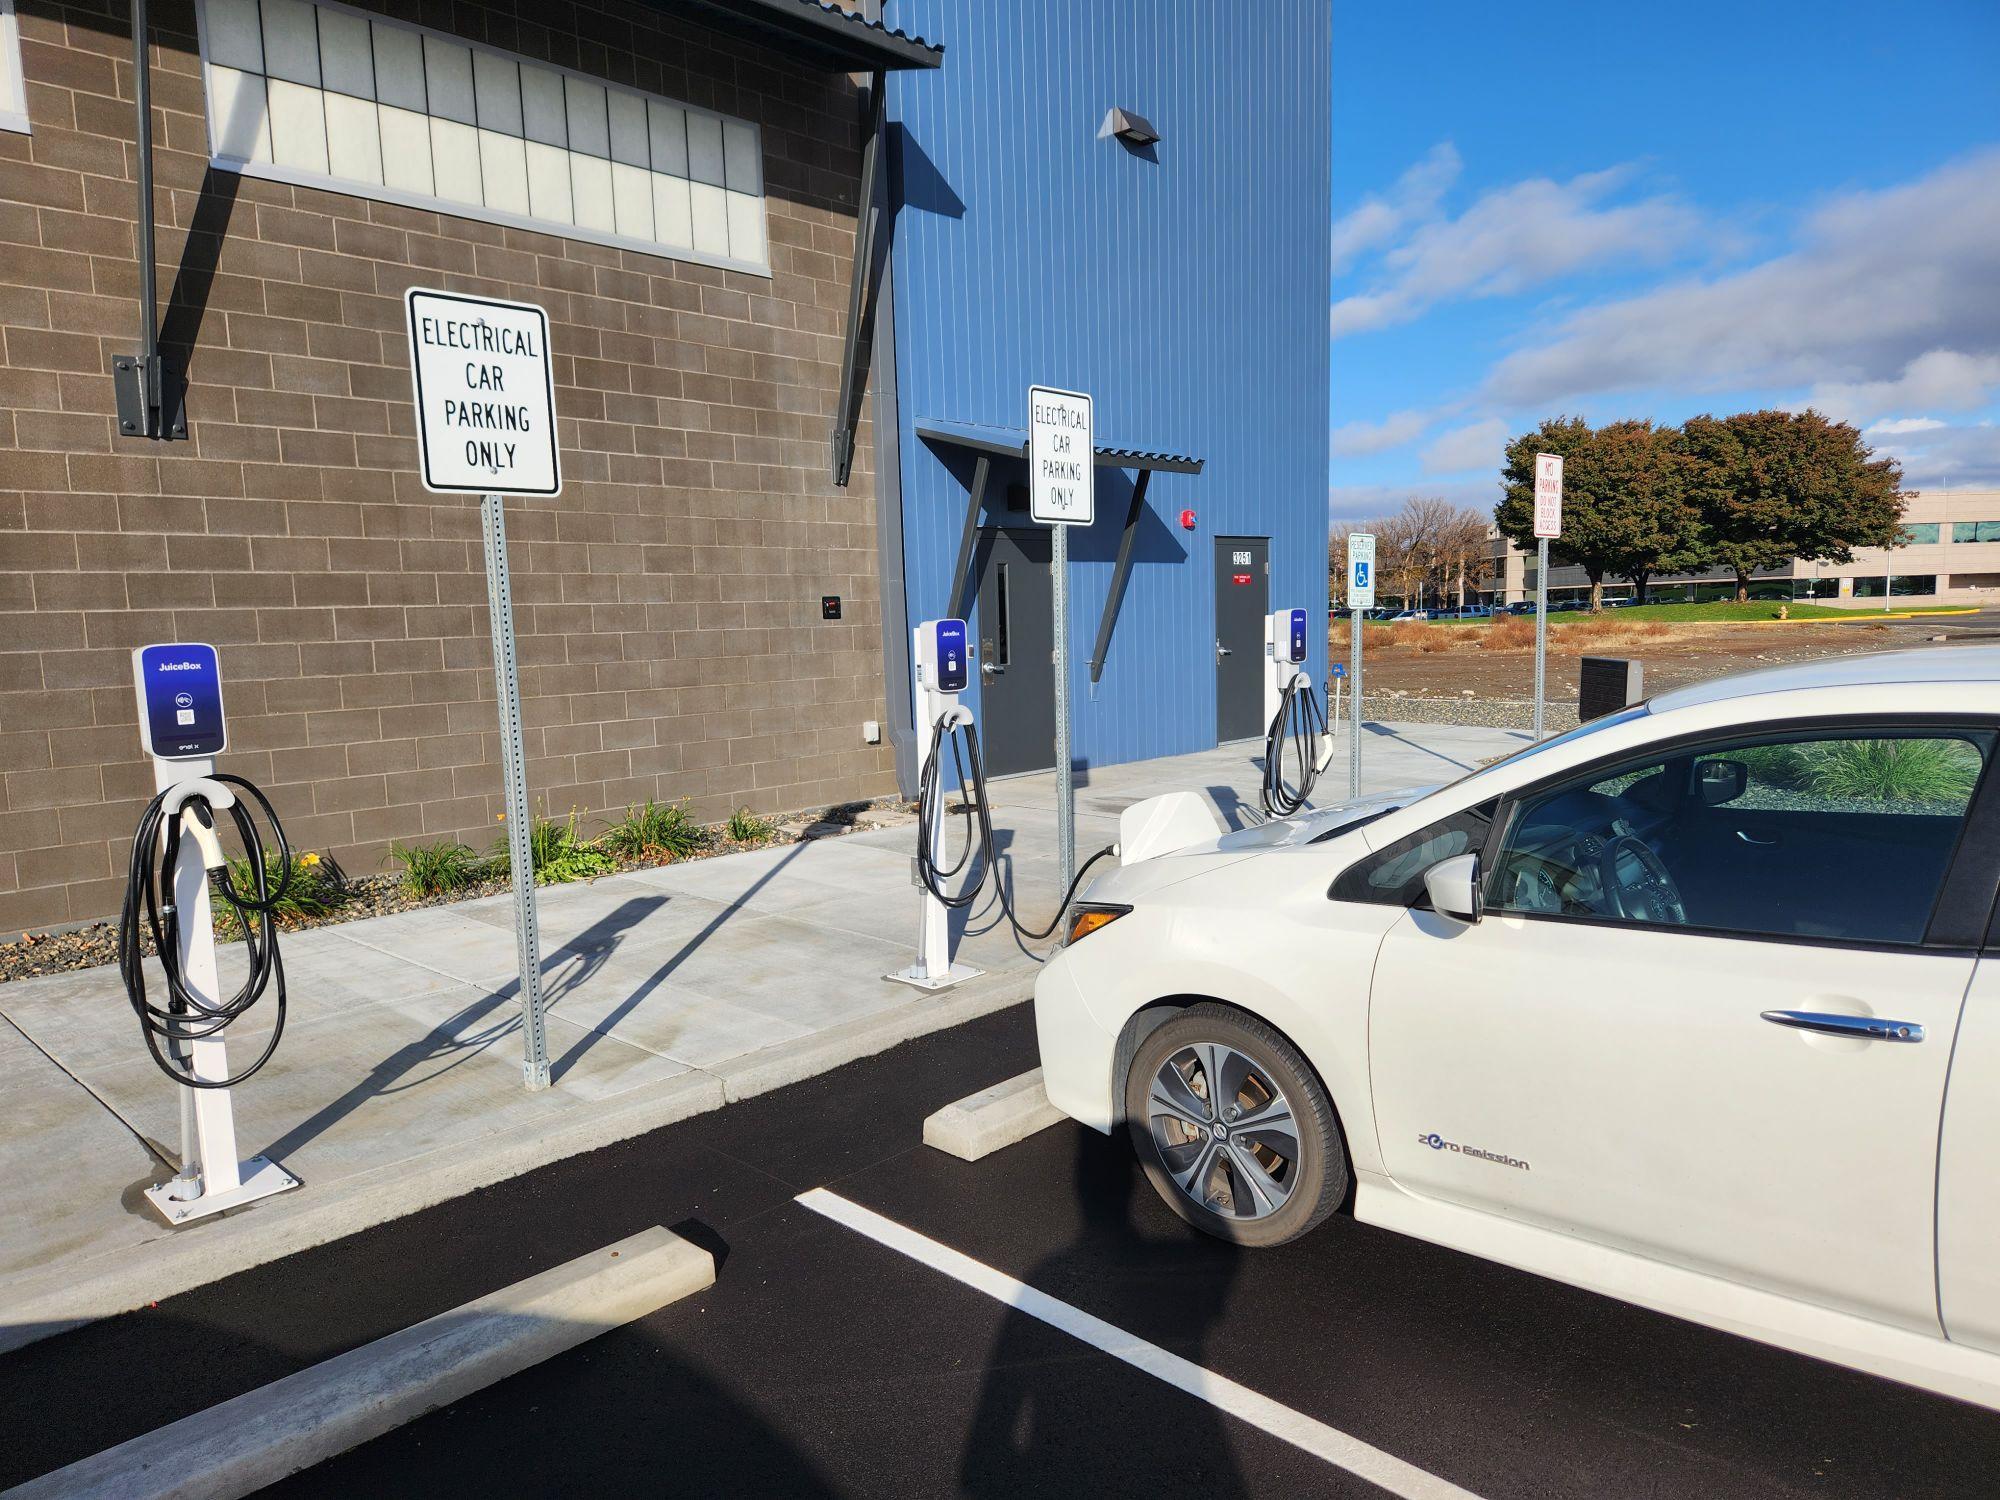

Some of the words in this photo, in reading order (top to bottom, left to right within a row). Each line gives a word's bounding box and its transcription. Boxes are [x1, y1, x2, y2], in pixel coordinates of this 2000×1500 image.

[423, 317, 538, 358] ELECTRICAL
[466, 362, 504, 392] CAR
[445, 400, 530, 432] PARKING
[1035, 404, 1087, 430] ELECTRICAL
[466, 440, 516, 469] ONLY
[1053, 434, 1071, 454] CAR
[1042, 459, 1081, 481] PARKING
[1050, 487, 1074, 507] ONLY
[159, 662, 202, 672] JuiceBox
